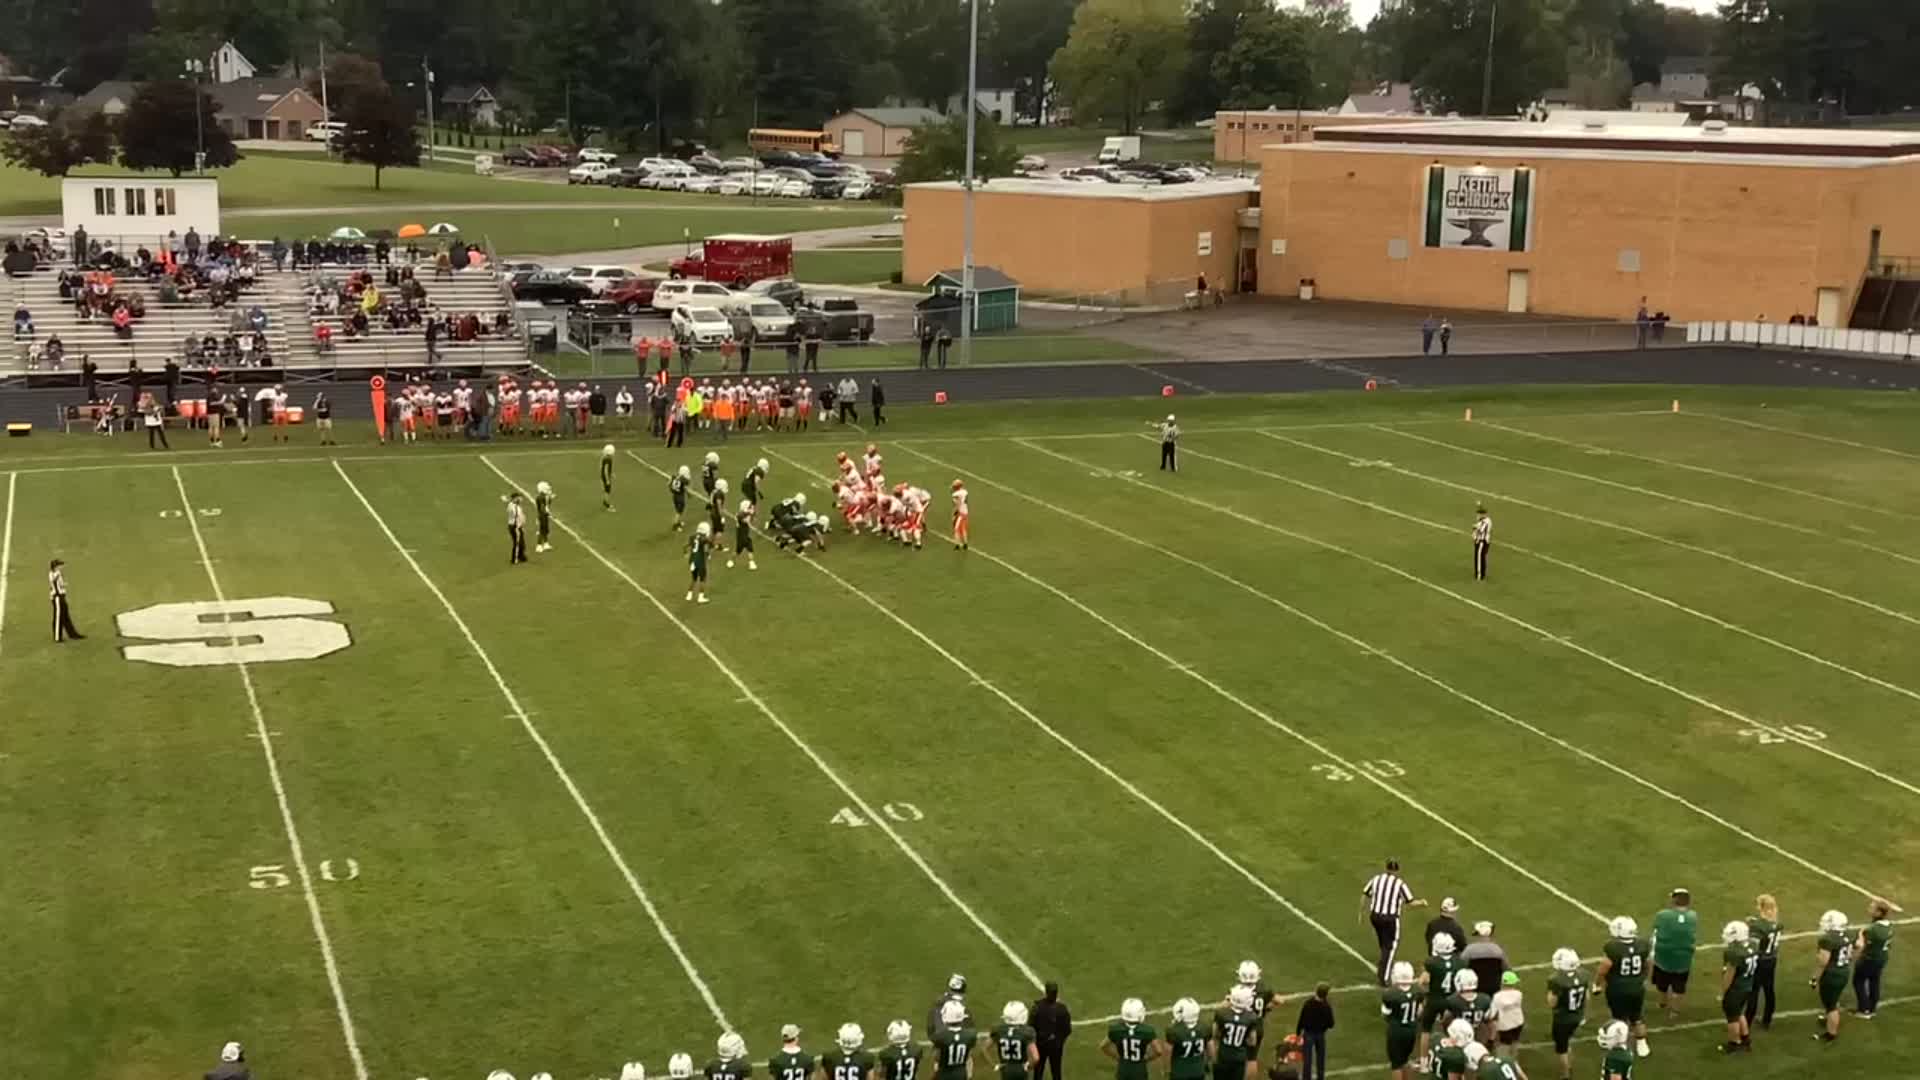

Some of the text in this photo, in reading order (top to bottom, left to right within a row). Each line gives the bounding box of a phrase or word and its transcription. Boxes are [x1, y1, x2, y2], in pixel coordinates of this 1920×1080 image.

[1459, 176, 1499, 192] KEITH
[1447, 191, 1510, 210] SCHROCK
[114, 596, 354, 667] S
[830, 802, 924, 827] 40
[248, 857, 360, 889] 50
[1620, 955, 1642, 976] 69
[1223, 1022, 1247, 1048] 30
[948, 1043, 967, 1065] 10
[999, 1039, 1022, 1060] 23
[1122, 1038, 1141, 1061] 15
[896, 1057, 915, 1080] 13
